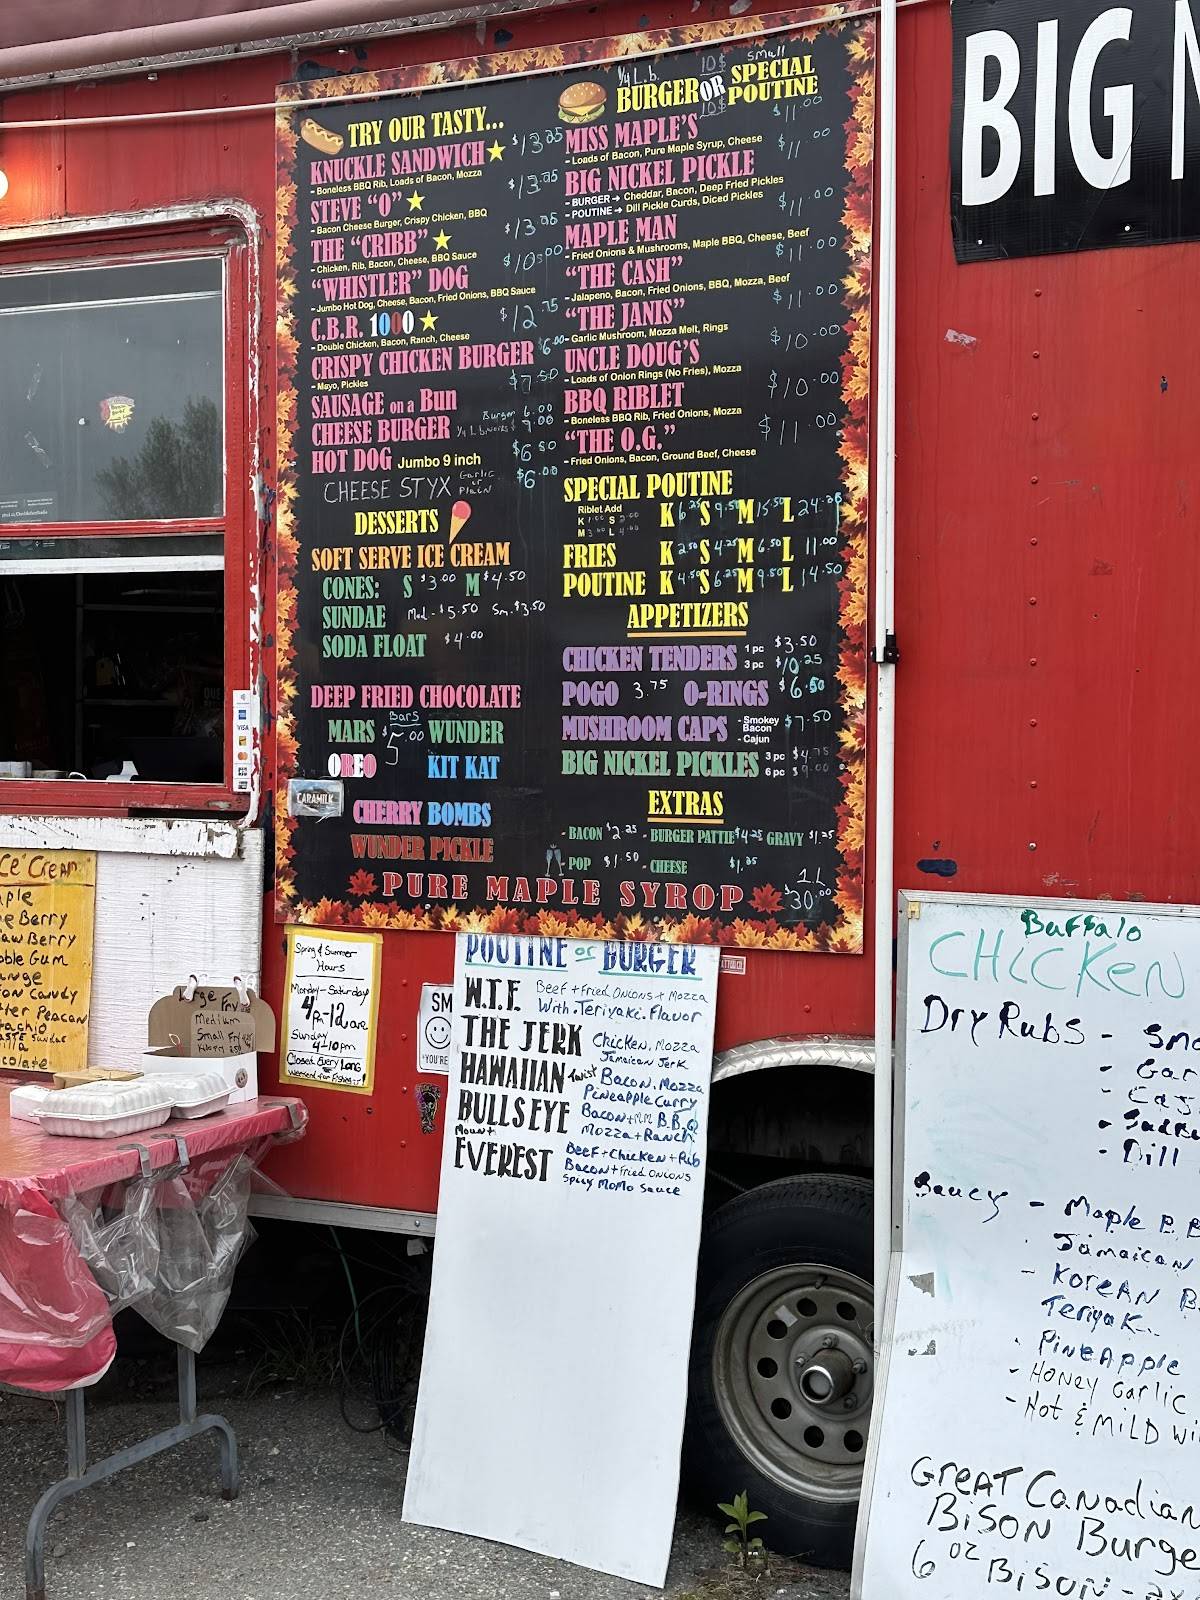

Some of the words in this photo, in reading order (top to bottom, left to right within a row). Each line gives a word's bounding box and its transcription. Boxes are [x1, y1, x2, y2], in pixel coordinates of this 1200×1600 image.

[731, 55, 816, 84] SPECIAL
[616, 77, 700, 114] BURGER
[700, 74, 726, 102] OR
[727, 75, 818, 106] POUTINE
[962, 7, 1133, 206] BIG
[348, 119, 384, 148] TRY
[388, 116, 426, 143] OUR
[431, 106, 505, 137] TASTY...
[565, 124, 608, 155] MISS
[615, 112, 699, 149] MAPLE’S
[310, 153, 386, 186] KNUCKLE
[391, 140, 486, 176] SANDWICH
[572, 155, 598, 165] Loads
[600, 152, 610, 162] of
[611, 149, 642, 161] Bacon,
[644, 146, 666, 156] Pure
[667, 143, 694, 155] Maple
[696, 139, 726, 152] Syrup,
[727, 133, 763, 147] Cheese
[316, 185, 352, 196] Boneless
[353, 182, 372, 193] BBQ
[373, 179, 389, 191] Rib,
[390, 177, 414, 188] Loads
[415, 175, 424, 185] of
[426, 172, 455, 184] Bacon,
[456, 169, 482, 180] Mozza
[565, 168, 601, 196] BIG
[608, 159, 675, 191] NICKEL
[682, 150, 755, 183] PICKLE
[310, 195, 362, 225] STEVE
[565, 218, 629, 250] MAPLE
[635, 213, 677, 243] MAN
[311, 237, 344, 263] THE
[428, 265, 469, 292] DOG
[311, 315, 364, 342] C.B.R.
[369, 310, 415, 338] 1000
[311, 353, 373, 380] CRISPY
[379, 346, 454, 376] CHICKEN
[458, 340, 534, 370] BURGER
[565, 346, 621, 374] UNCLE
[627, 338, 700, 368] DOUG’S
[317, 381, 340, 391] Mayo,
[341, 379, 369, 389] Pickles
[563, 388, 608, 415] BBQ
[613, 382, 685, 411] RIBLET
[311, 391, 385, 420] SAUSAGE
[389, 400, 405, 414] on
[407, 401, 415, 413] a
[419, 388, 458, 413] Bun
[311, 420, 373, 446] CHEESE
[377, 415, 451, 443] BURGER
[311, 450, 349, 474] HOT
[353, 447, 393, 472] DOG
[398, 454, 441, 469] Jumbo
[442, 454, 451, 467] 9
[454, 452, 482, 466] inch
[323, 479, 391, 504] CHEESE
[399, 476, 452, 500] STYX
[563, 474, 641, 502] SPECIAL
[646, 469, 733, 499] POUTINE
[354, 509, 439, 536] DESSERTS
[578, 504, 603, 514] Riblet
[604, 503, 622, 514] Add
[311, 547, 353, 572] SOFT
[358, 545, 412, 570] SERVE
[417, 544, 445, 568] ICE
[450, 542, 511, 567] CREAM
[563, 543, 617, 569] FRIES
[322, 575, 380, 600] CONES:
[403, 574, 413, 599] S
[466, 572, 481, 597] M
[563, 571, 646, 597] POUTINE
[322, 604, 386, 629] SUNDAE
[627, 601, 749, 629] APPETIZERS
[322, 634, 368, 658] SODA
[373, 633, 427, 657] FLOAT
[562, 646, 643, 672] CHICKEN
[649, 645, 738, 671] TENDERS
[310, 684, 356, 709] DEEP
[361, 684, 413, 709] FRIED
[419, 684, 522, 709] CHOCOLATE
[562, 680, 620, 707] POGO
[683, 680, 769, 707] O-RINGS
[327, 718, 376, 744] MARS
[428, 719, 505, 745] WUNDER
[561, 715, 673, 742] MUSHROOM
[677, 715, 728, 742] CAPS
[742, 723, 772, 733] Bacon
[743, 715, 780, 726] Smokey
[743, 734, 770, 745] Cajun
[327, 752, 377, 779] OREO
[427, 756, 461, 779] KIT
[465, 755, 500, 780] KAT
[561, 750, 598, 775] BIG
[604, 751, 672, 777] NICKEL
[676, 751, 760, 778] PICKLES
[353, 800, 424, 826] CHERRY
[427, 801, 492, 827] BOMBS
[648, 790, 725, 816] EXTRAS
[350, 834, 426, 861] WUNDER
[430, 836, 495, 863] PICKLE
[568, 826, 603, 841] BACON
[650, 828, 694, 844] BURGER
[697, 829, 735, 845] PATTIE
[766, 831, 804, 847] GRAVY
[568, 856, 591, 871] POP
[650, 859, 688, 875] CHEESE
[382, 871, 469, 900] PURE
[486, 875, 601, 906] MAPLE
[619, 880, 745, 912] SYROP
[465, 934, 568, 969] POUTINE
[602, 940, 697, 976] BURGER
[461, 1015, 511, 1050] THE
[518, 1020, 583, 1057] JERK
[460, 1052, 566, 1094] HAWAIIAN
[454, 1136, 554, 1182] EVEREST
